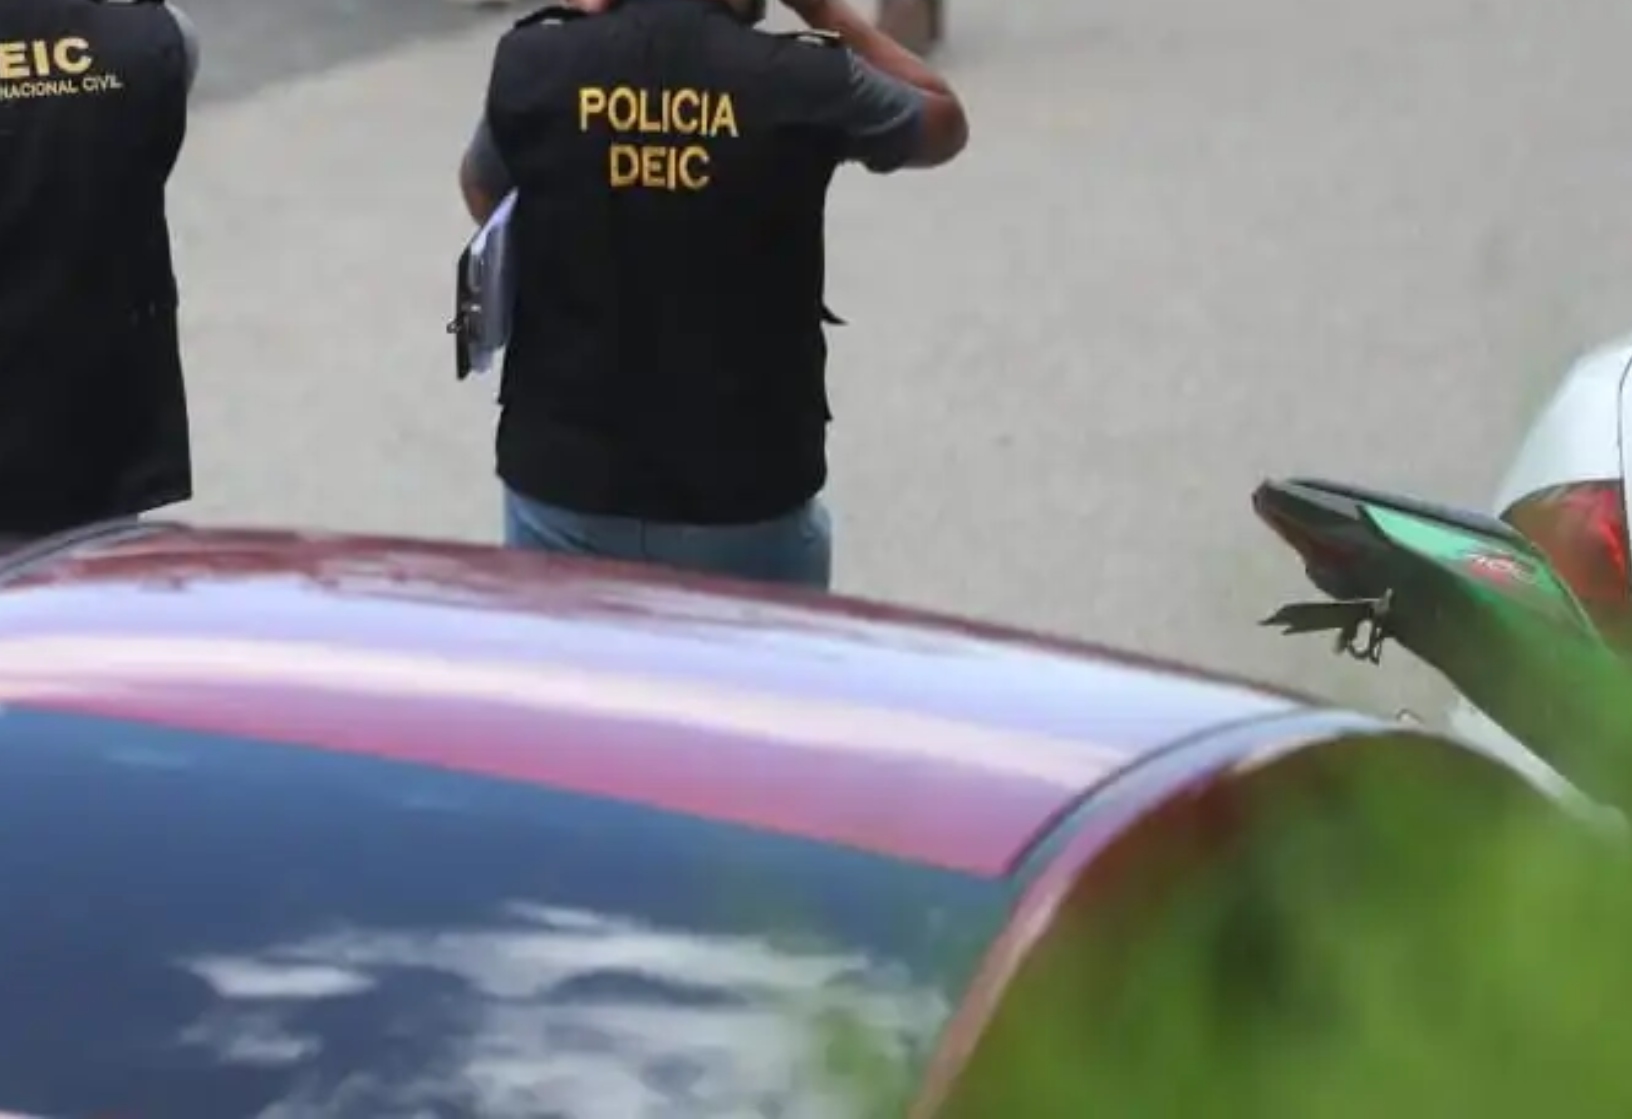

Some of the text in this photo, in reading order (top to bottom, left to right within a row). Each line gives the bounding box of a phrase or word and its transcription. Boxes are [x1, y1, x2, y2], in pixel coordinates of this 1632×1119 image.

[82, 73, 123, 93] CIVIL
[579, 86, 739, 138] POLICIA
[609, 144, 710, 191] DEIC
